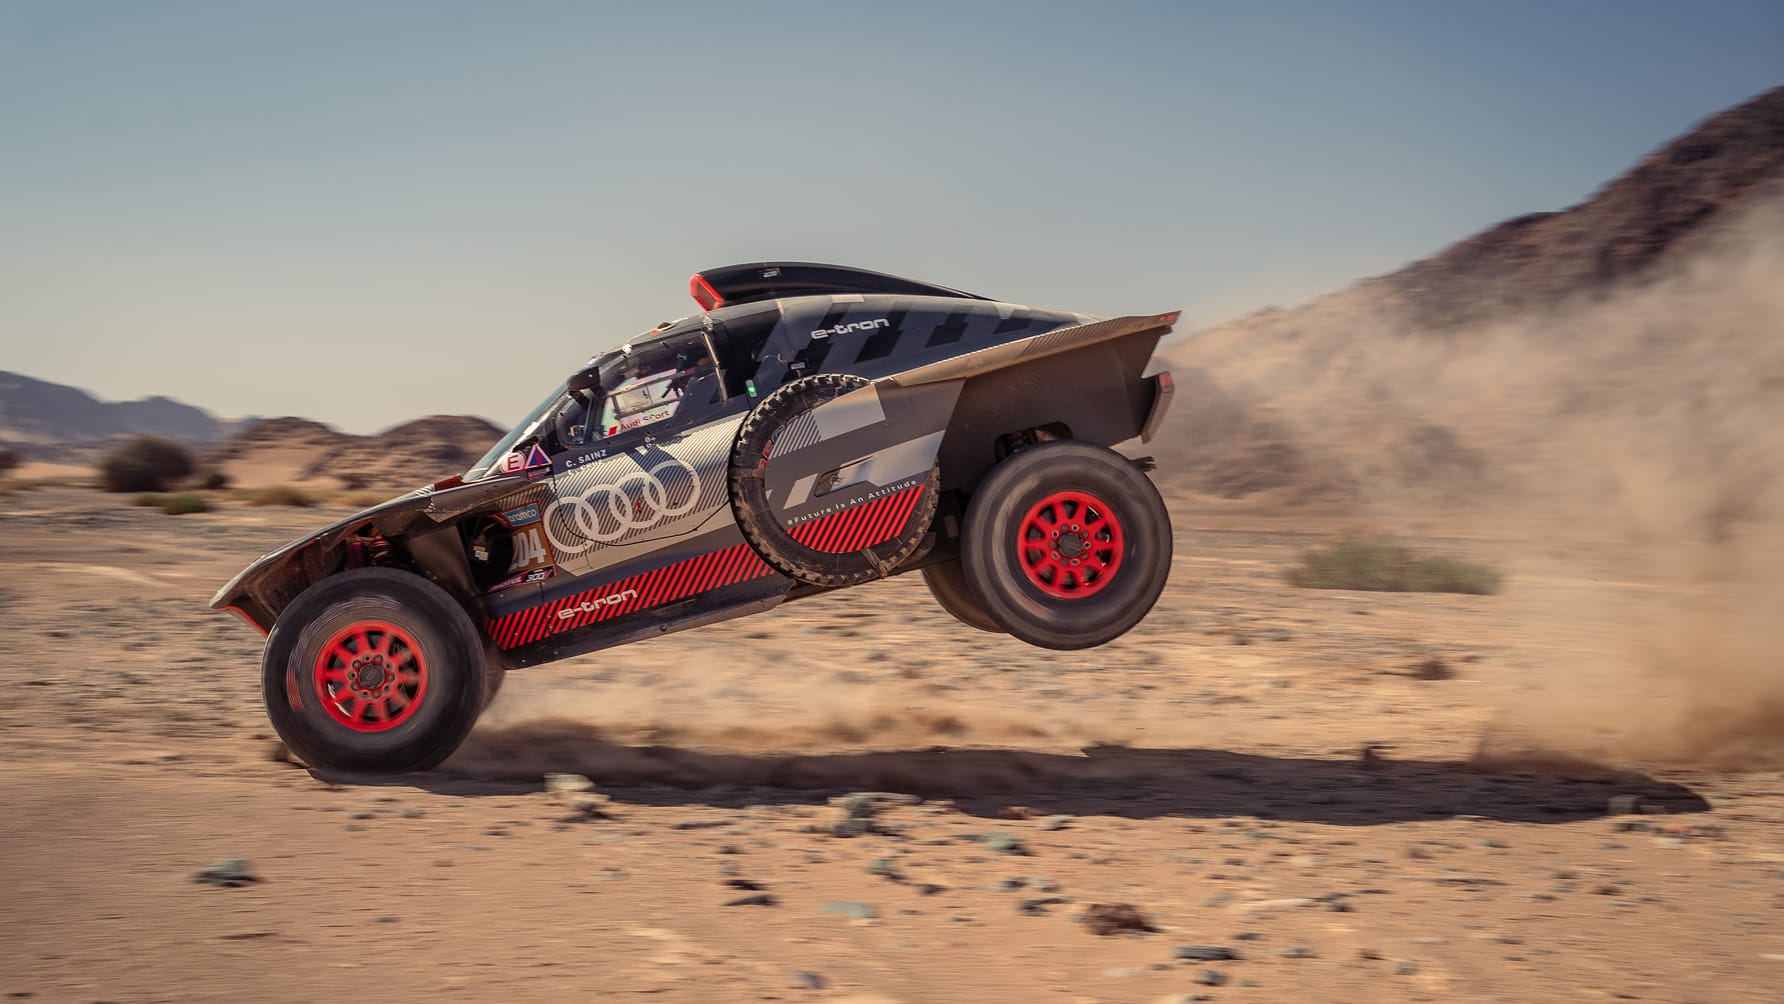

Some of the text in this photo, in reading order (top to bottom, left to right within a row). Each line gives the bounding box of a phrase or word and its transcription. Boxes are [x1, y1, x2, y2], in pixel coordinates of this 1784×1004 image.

[810, 318, 890, 340] e-tron
[620, 418, 642, 432] Audi
[507, 454, 519, 471] E
[565, 449, 608, 468] C. SAINZ
[850, 497, 864, 505] An
[868, 480, 917, 499] Attitude
[558, 589, 638, 619] e-tron
